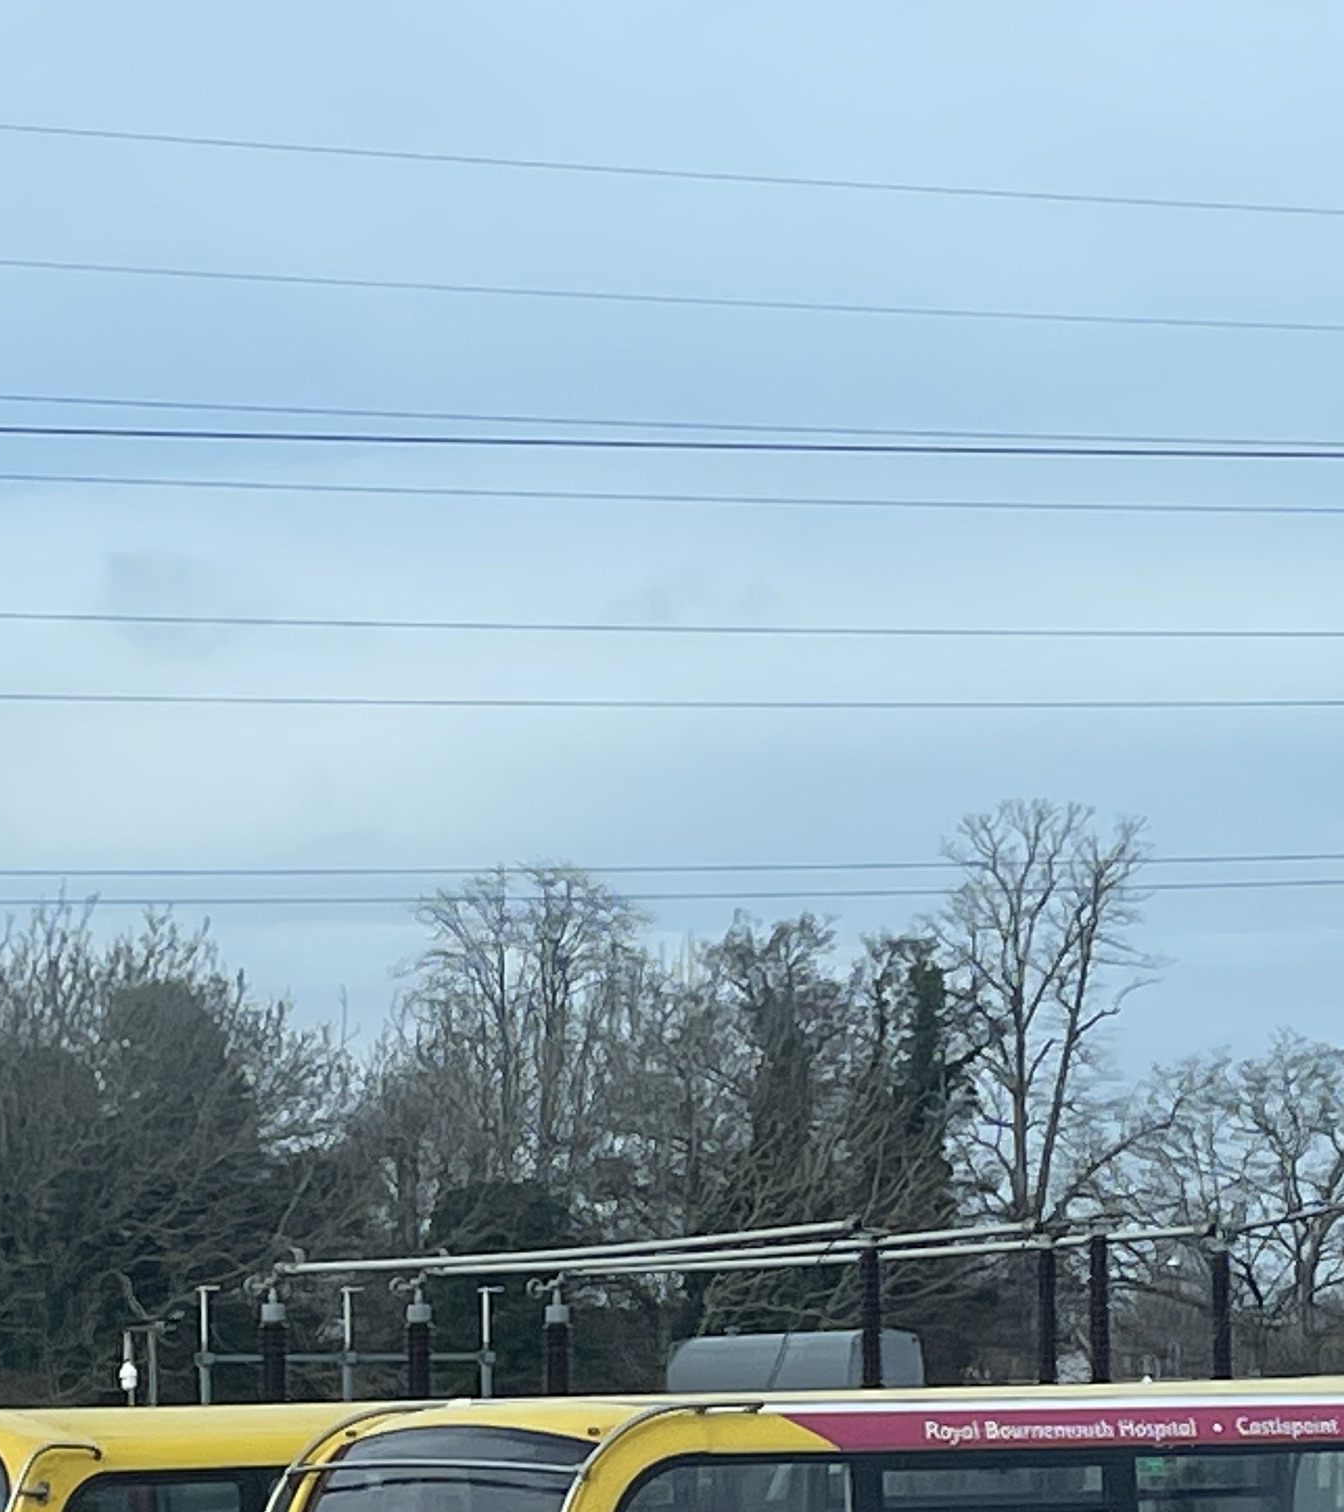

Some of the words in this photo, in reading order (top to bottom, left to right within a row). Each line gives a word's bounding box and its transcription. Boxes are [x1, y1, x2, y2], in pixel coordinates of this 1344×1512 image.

[924, 1420, 979, 1445] Royal
[985, 1418, 1114, 1440] Bournemouth
[1118, 1418, 1197, 1442] Hospital
[1236, 1416, 1339, 1440] Castlepoint
